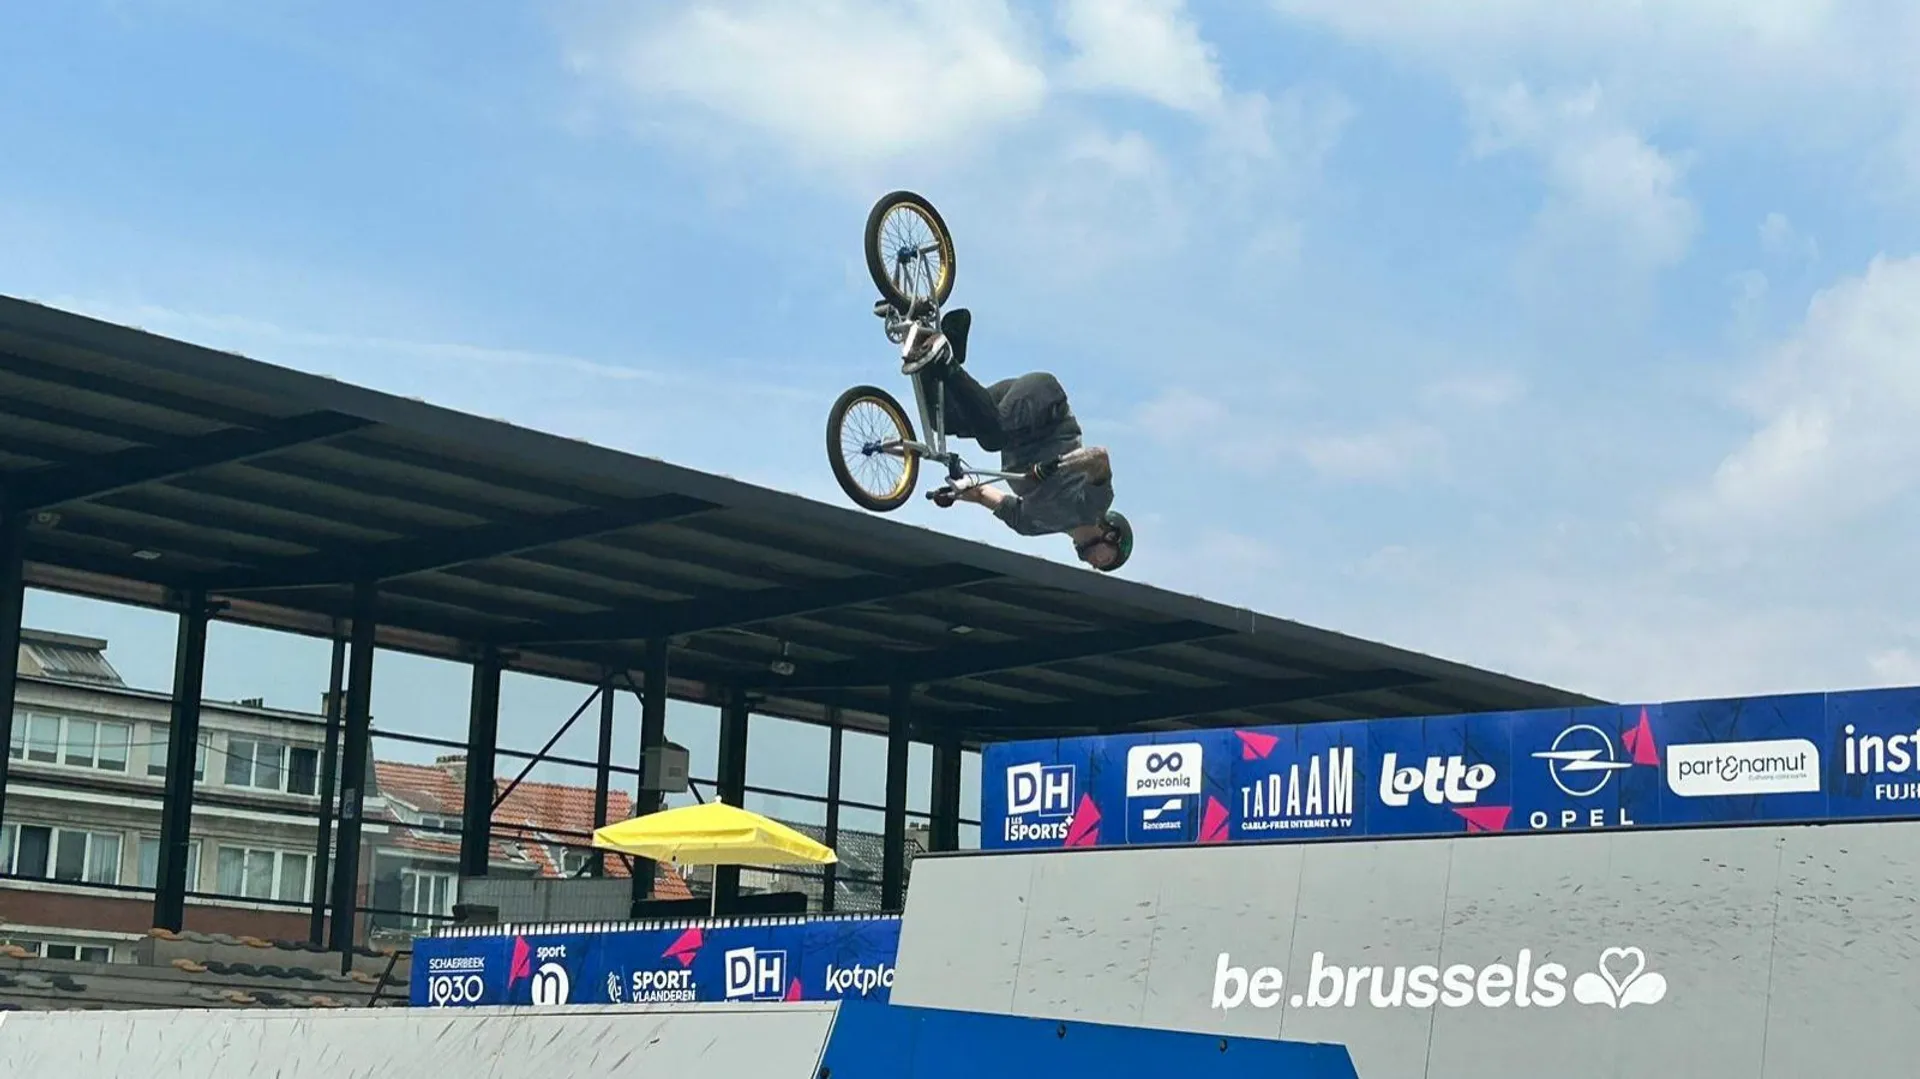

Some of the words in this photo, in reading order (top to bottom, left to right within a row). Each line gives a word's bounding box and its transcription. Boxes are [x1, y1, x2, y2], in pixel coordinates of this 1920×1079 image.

[1012, 770, 1071, 810] DH
[1137, 774, 1190, 791] payconiq
[1241, 746, 1353, 818] TADAAM
[1290, 819, 1330, 829] INTERNET
[1340, 818, 1352, 828] TV
[1530, 807, 1634, 829] OPEL
[429, 957, 485, 970] SCHAERBEEK
[536, 944, 567, 961] sport
[729, 955, 781, 994] DH
[1211, 948, 1567, 1009] be.brussels
[428, 975, 484, 1004] 1030
[632, 989, 696, 1002] VLAANDEREN
